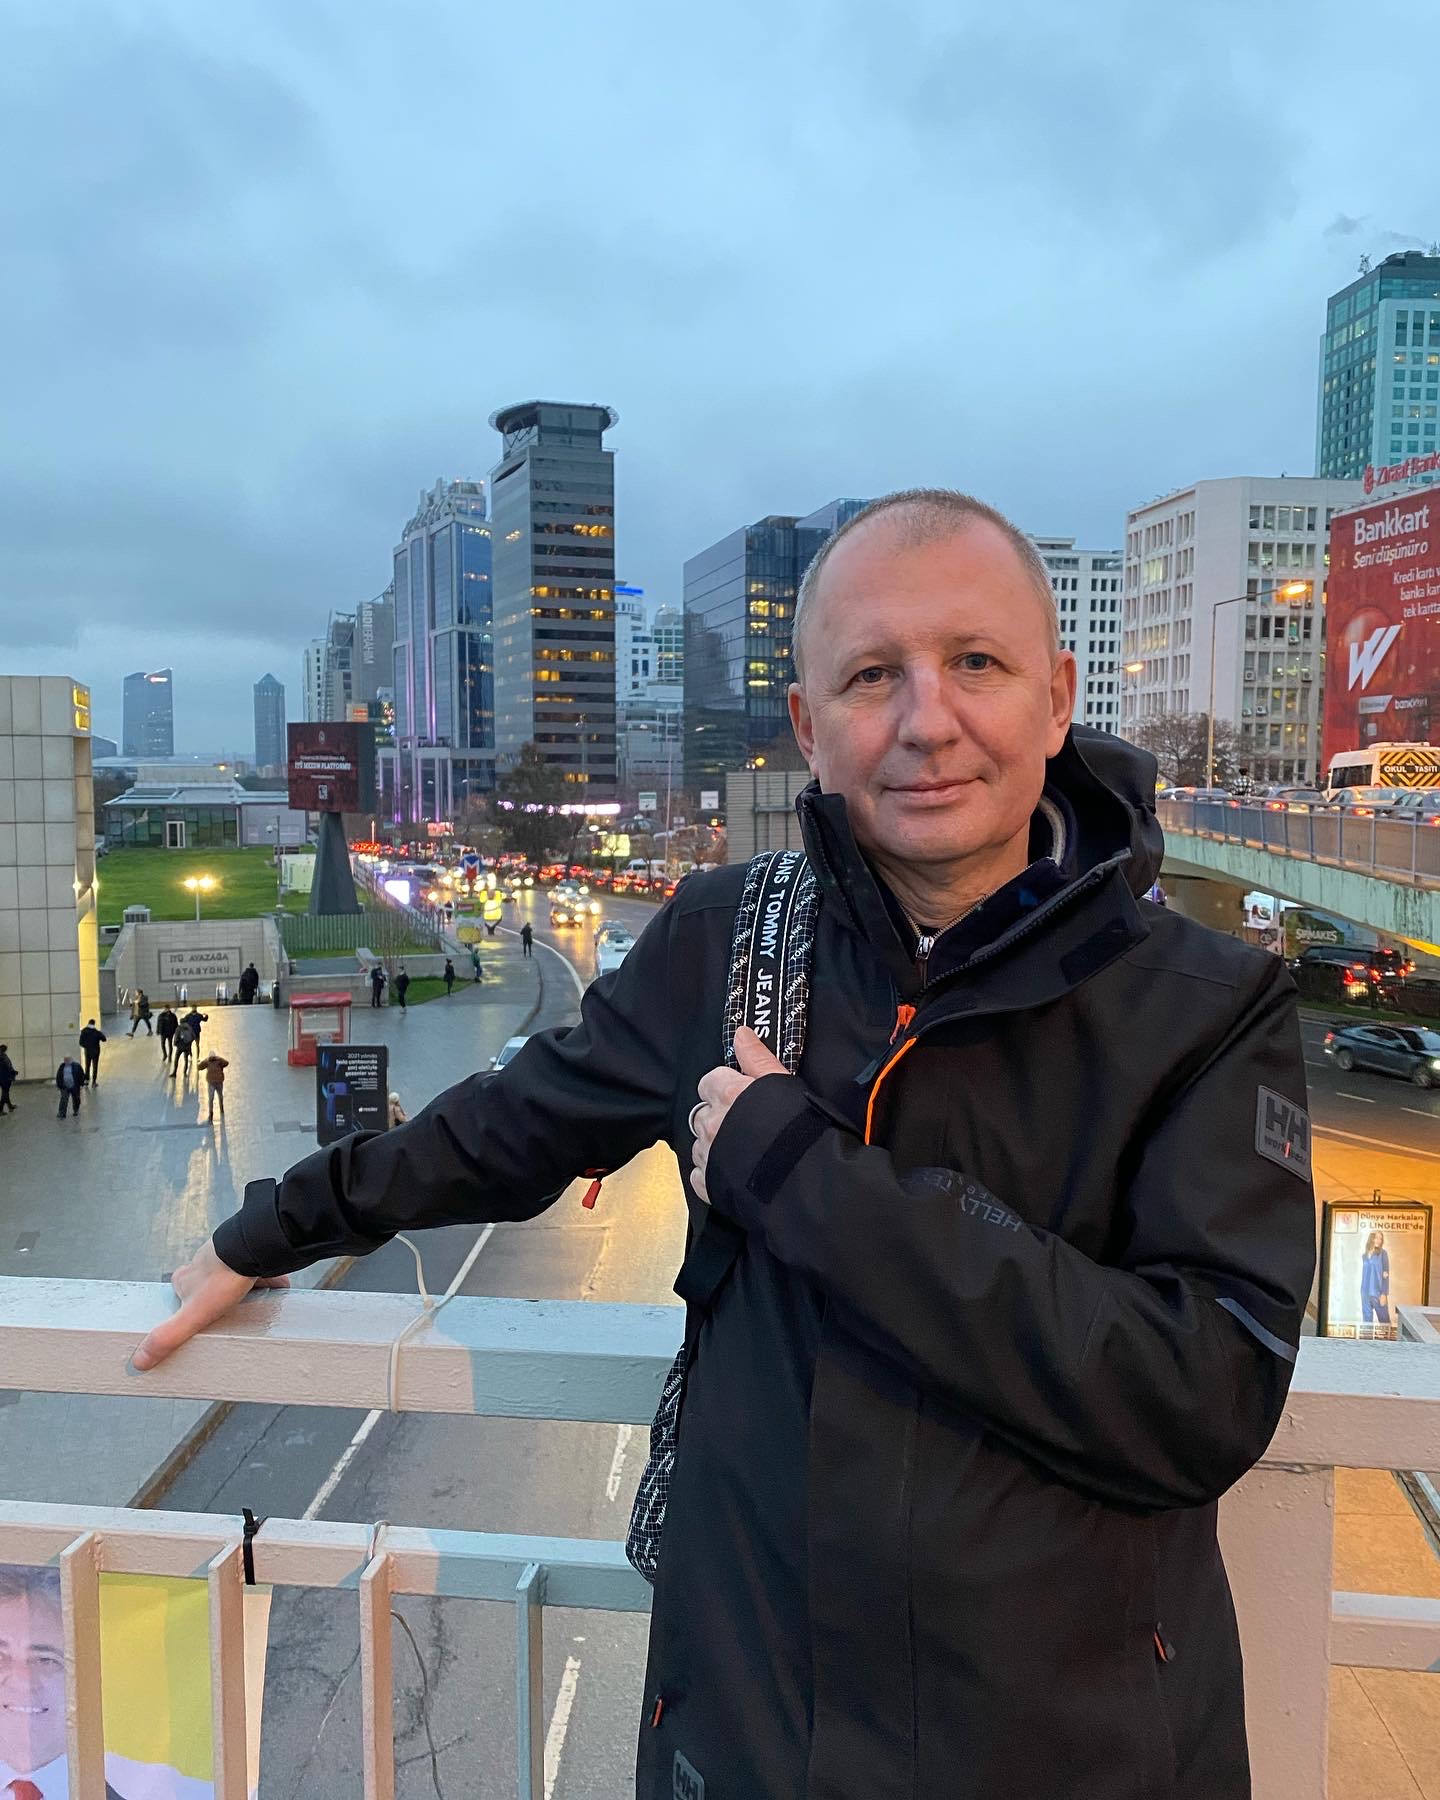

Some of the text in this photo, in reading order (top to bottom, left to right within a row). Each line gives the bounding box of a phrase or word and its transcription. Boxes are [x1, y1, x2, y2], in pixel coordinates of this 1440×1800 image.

[1354, 505, 1430, 545] Bankkart
[1353, 548, 1374, 569] Seni
[1393, 569, 1415, 584] Kredi
[1400, 585, 1425, 601] banka
[1403, 603, 1416, 618] tek
[1384, 765, 1407, 773] OKUL
[753, 851, 801, 1039] EANS TOMMY JEANS
[785, 1001, 806, 1027] JEANS
[1360, 1211, 1385, 1221] Dünya
[1369, 1222, 1425, 1230] LINGERIE'de
[664, 1374, 684, 1398] TOMMY
